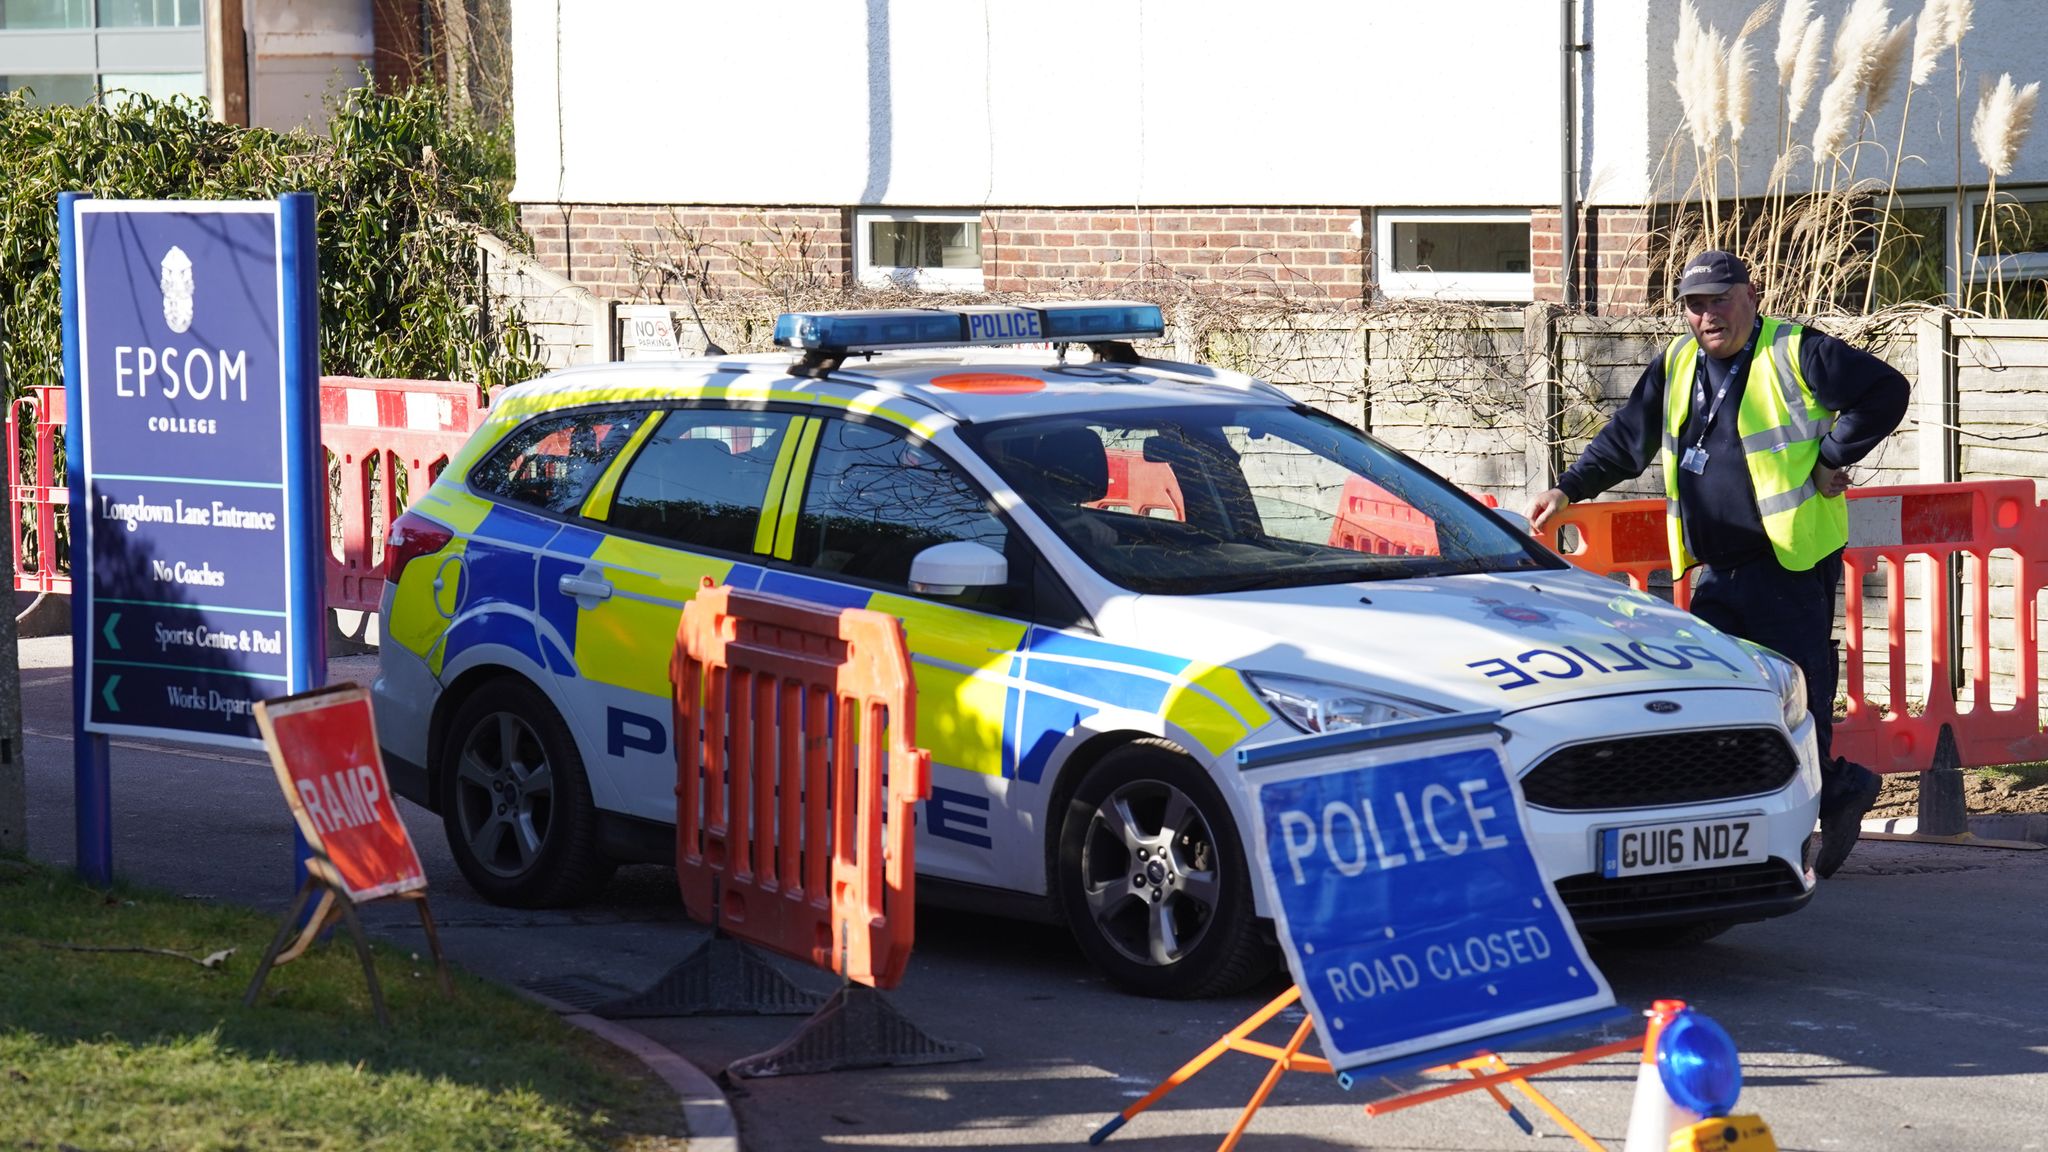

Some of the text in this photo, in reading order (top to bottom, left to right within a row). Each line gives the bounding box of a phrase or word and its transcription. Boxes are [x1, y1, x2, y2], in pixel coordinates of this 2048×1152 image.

[635, 321, 655, 337] NO
[969, 312, 1040, 338] POLICE
[115, 346, 247, 401] EPSOM
[148, 416, 217, 435] COLLEGE
[101, 495, 276, 532] Longdown Lane Entrance
[153, 559, 225, 587] No Coaches
[155, 622, 281, 655] Sports Centre & Pool
[167, 685, 207, 711] Works
[296, 765, 382, 835] RAMP
[1279, 778, 1509, 886] POLICE
[1622, 822, 1750, 869] GU16 NDZ
[1606, 859, 1616, 870] GB
[1325, 926, 1551, 1003] ROAD CLOSED
